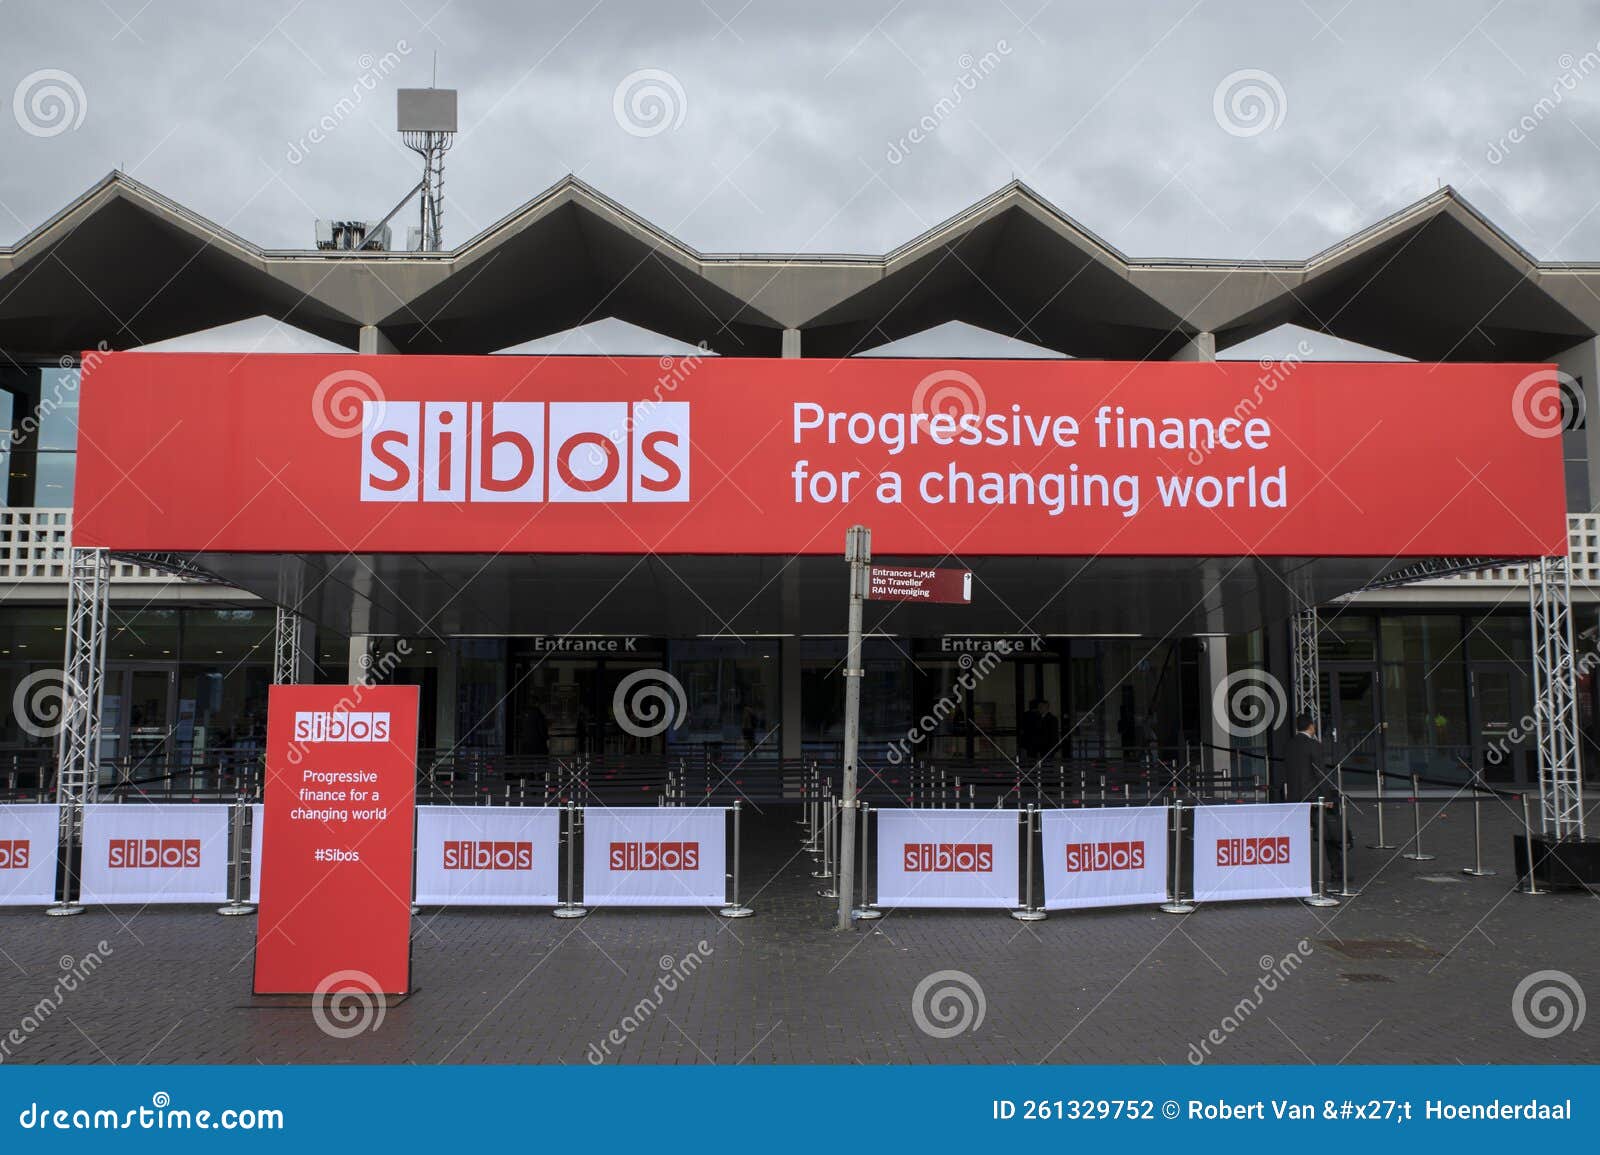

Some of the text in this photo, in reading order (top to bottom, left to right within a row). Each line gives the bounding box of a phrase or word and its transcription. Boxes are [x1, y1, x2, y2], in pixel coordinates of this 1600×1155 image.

[792, 402, 1271, 455] Progressive finance
[367, 405, 684, 495] sibos
[791, 460, 1287, 517] for a changing world
[872, 568, 912, 578] Entrances
[872, 577, 923, 587] the Traveller
[871, 586, 930, 598] RAI Vereniging
[535, 637, 637, 651] Entrance K
[941, 638, 1042, 651] Entrance K
[296, 714, 388, 739] sibos
[303, 770, 378, 785] Progressive
[299, 789, 379, 801] finance for a
[290, 807, 387, 823] changing world
[110, 840, 200, 867] sibos
[314, 849, 360, 862] #Sibos
[444, 842, 532, 869] sibos
[611, 843, 699, 870] sibos
[905, 845, 992, 872] sibos
[1067, 842, 1144, 872] sibos
[1217, 838, 1289, 865] sibos
